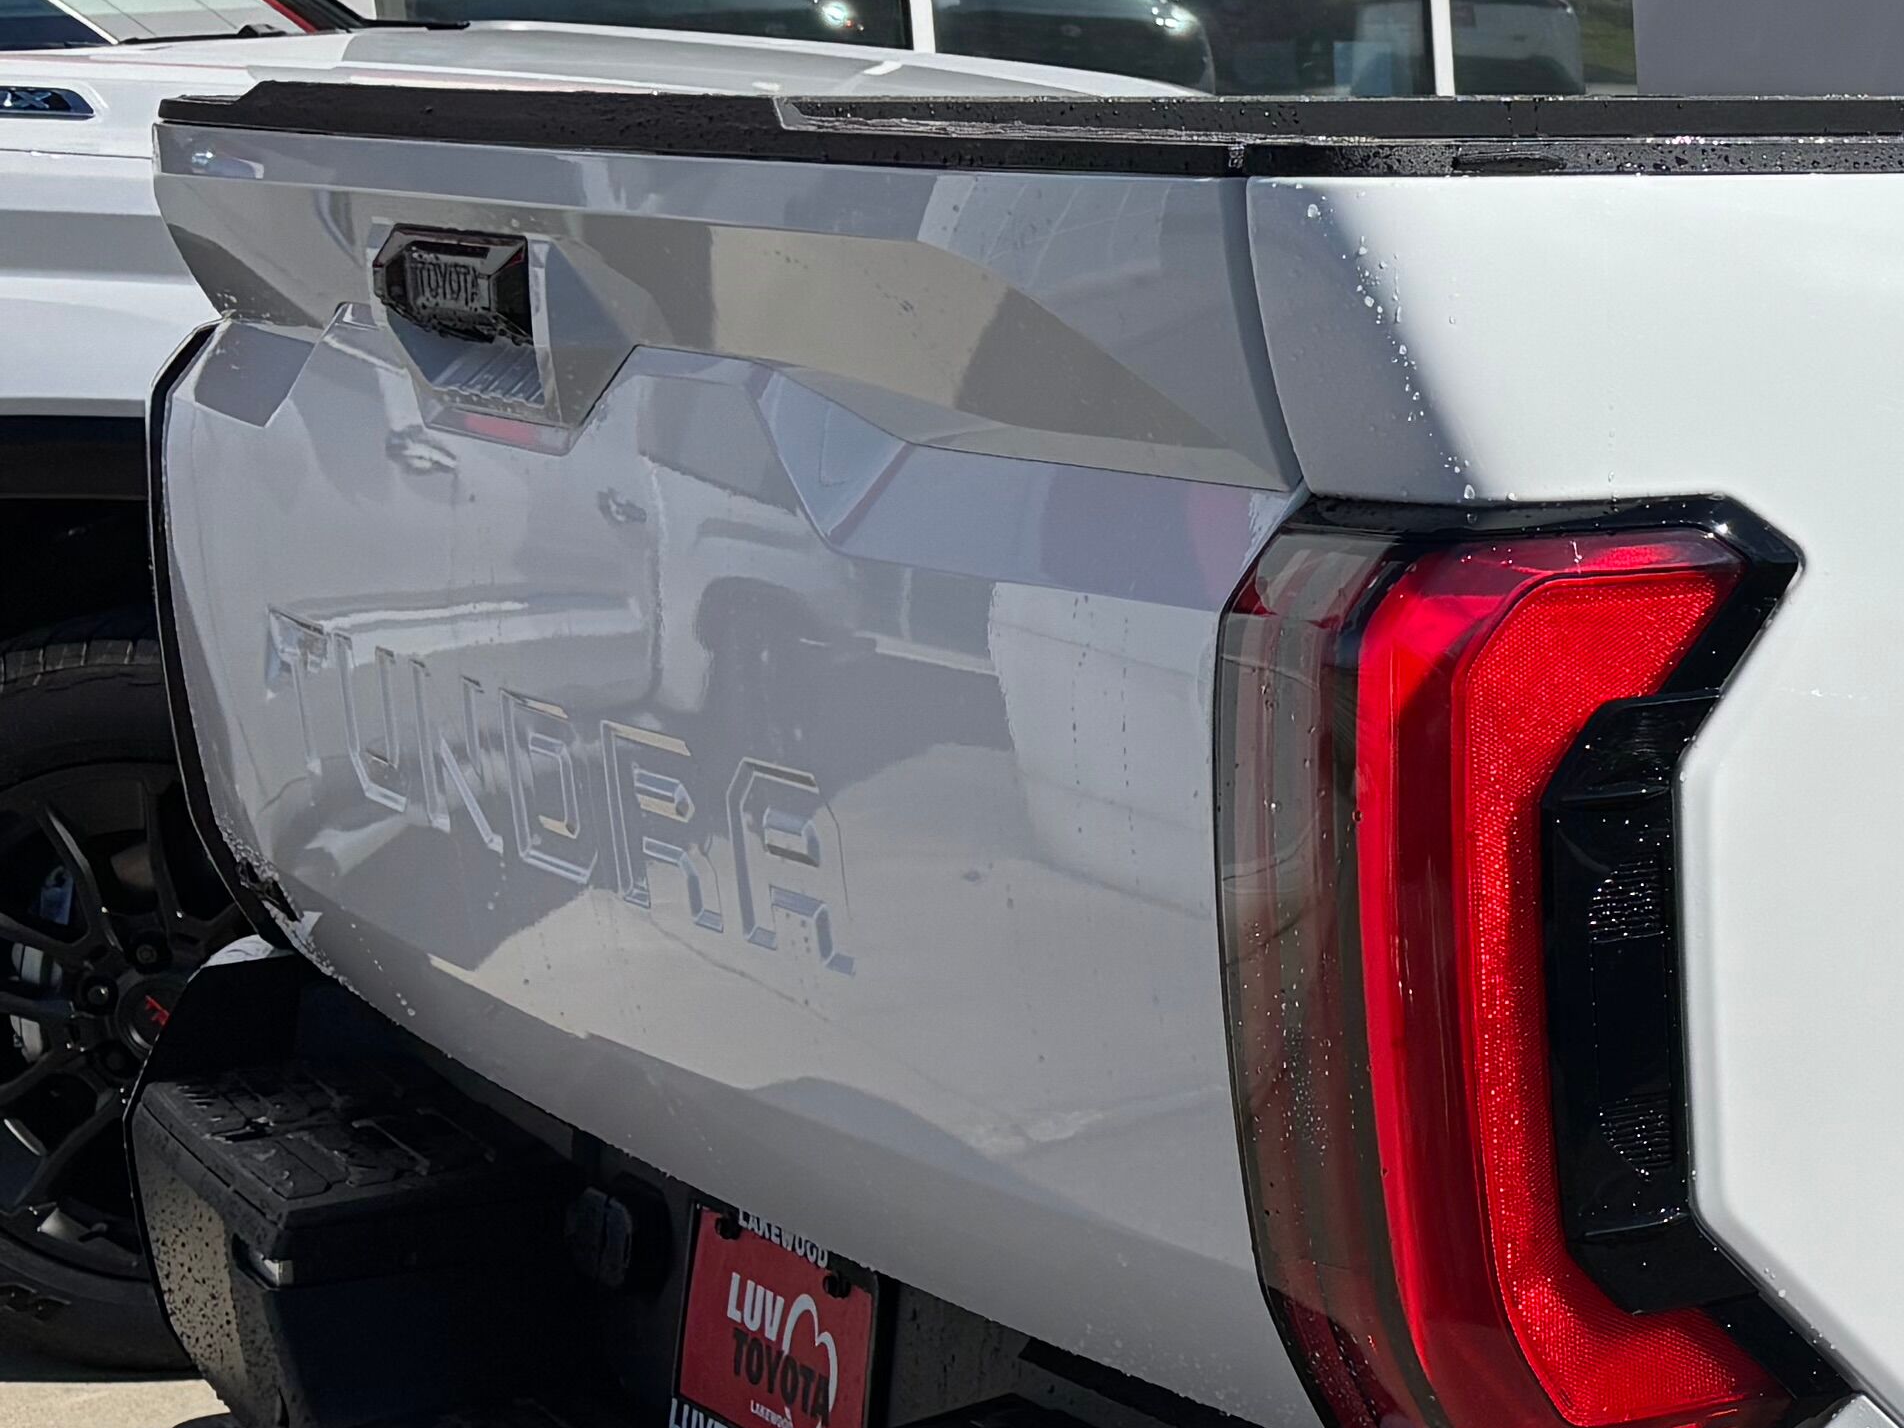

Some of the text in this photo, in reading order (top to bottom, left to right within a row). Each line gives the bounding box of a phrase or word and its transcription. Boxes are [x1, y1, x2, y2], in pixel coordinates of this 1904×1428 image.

[411, 260, 480, 308] TOYOTA
[264, 603, 857, 978] TUNDRA
[737, 1207, 829, 1269] LAKEWOOD
[726, 1272, 785, 1342] LUV
[732, 1327, 831, 1427] TOYOTA
